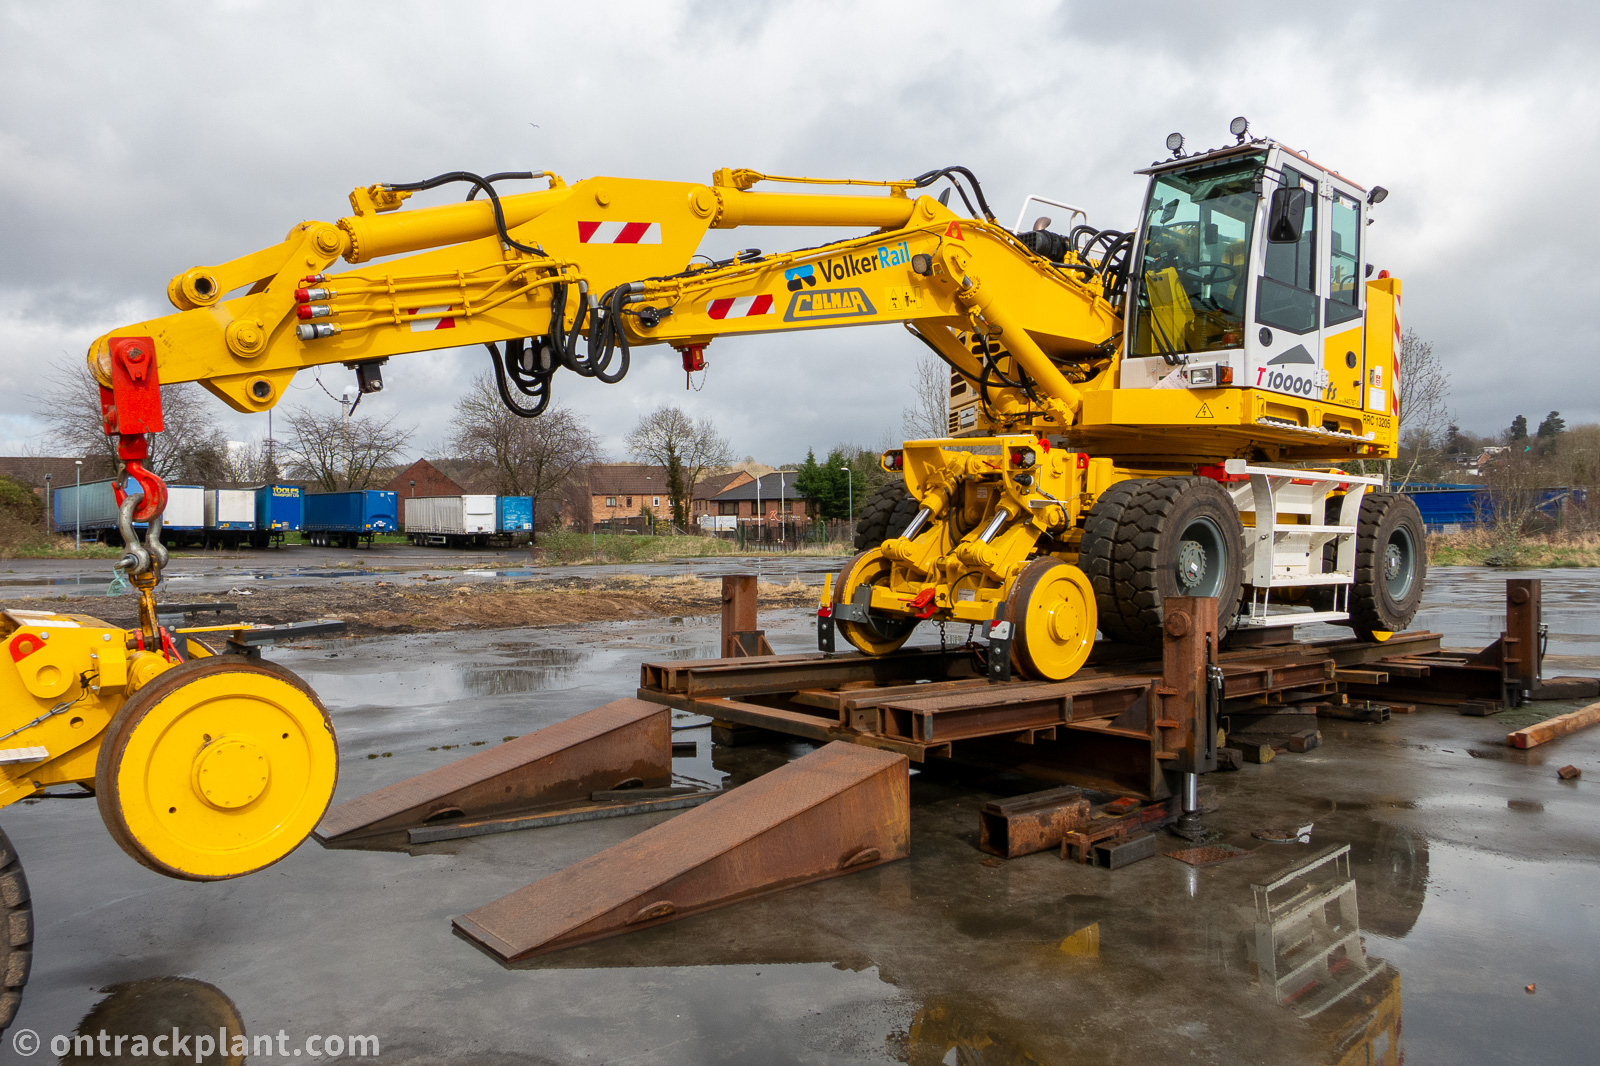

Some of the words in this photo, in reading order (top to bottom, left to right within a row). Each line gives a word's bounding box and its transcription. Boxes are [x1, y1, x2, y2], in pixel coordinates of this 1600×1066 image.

[818, 241, 911, 283] VolkerRail
[793, 291, 868, 318] COLMAR
[1256, 367, 1267, 386] T
[1267, 370, 1312, 396] 10000
[1326, 382, 1338, 400] fs
[1363, 414, 1375, 426] RRC
